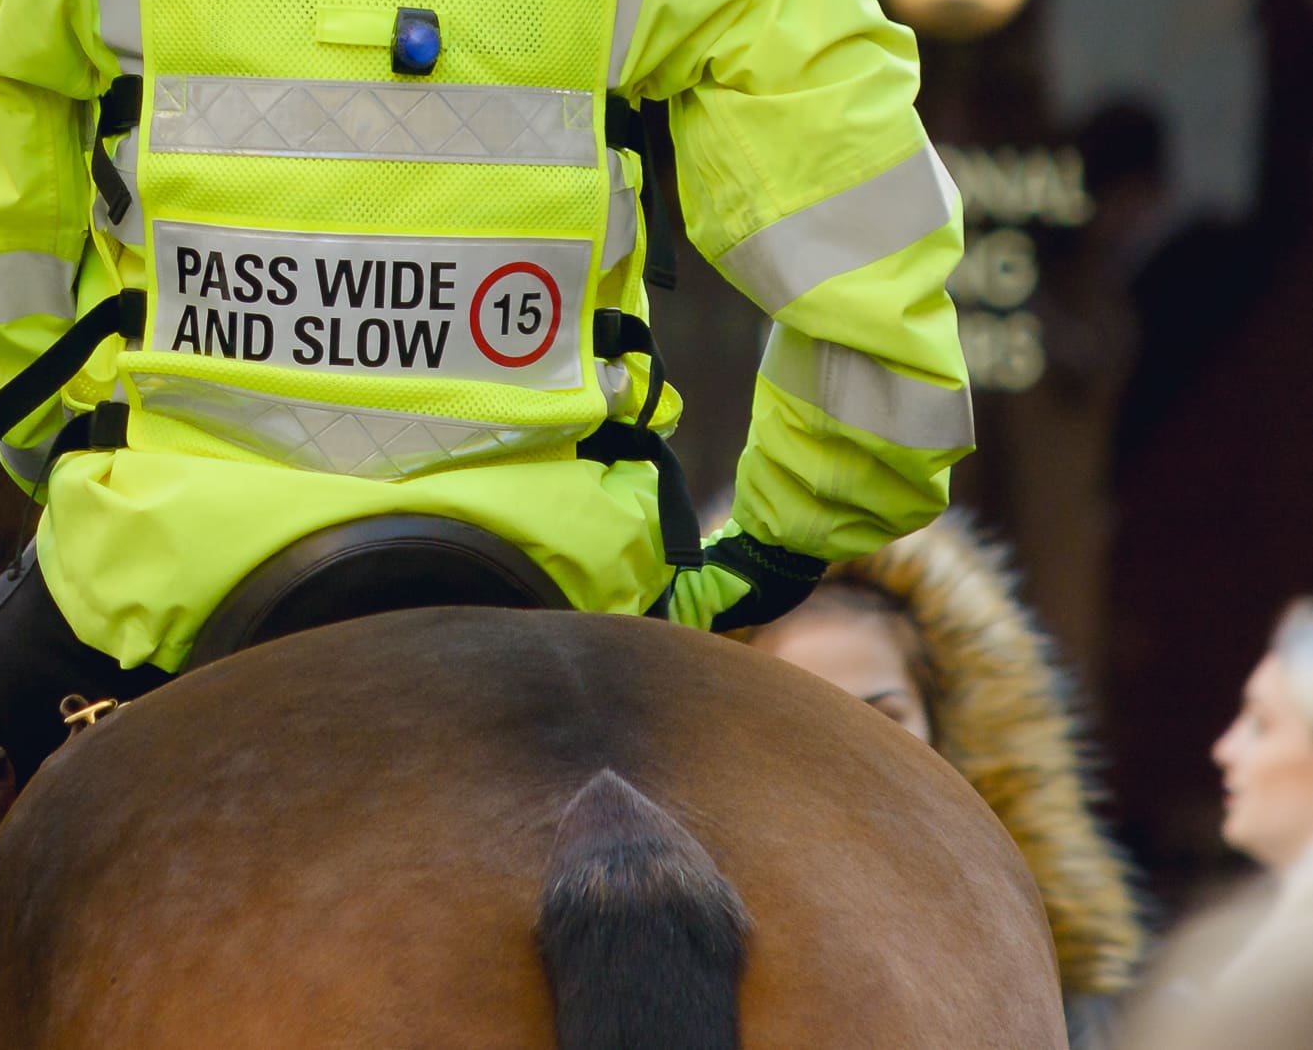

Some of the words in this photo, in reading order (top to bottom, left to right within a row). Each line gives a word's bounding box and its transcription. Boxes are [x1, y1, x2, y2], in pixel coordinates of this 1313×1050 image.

[176, 246, 298, 306] PASS
[315, 258, 457, 312] WIDE
[172, 303, 275, 363] AND
[293, 315, 451, 370] SLOW
[493, 292, 543, 336] 15
